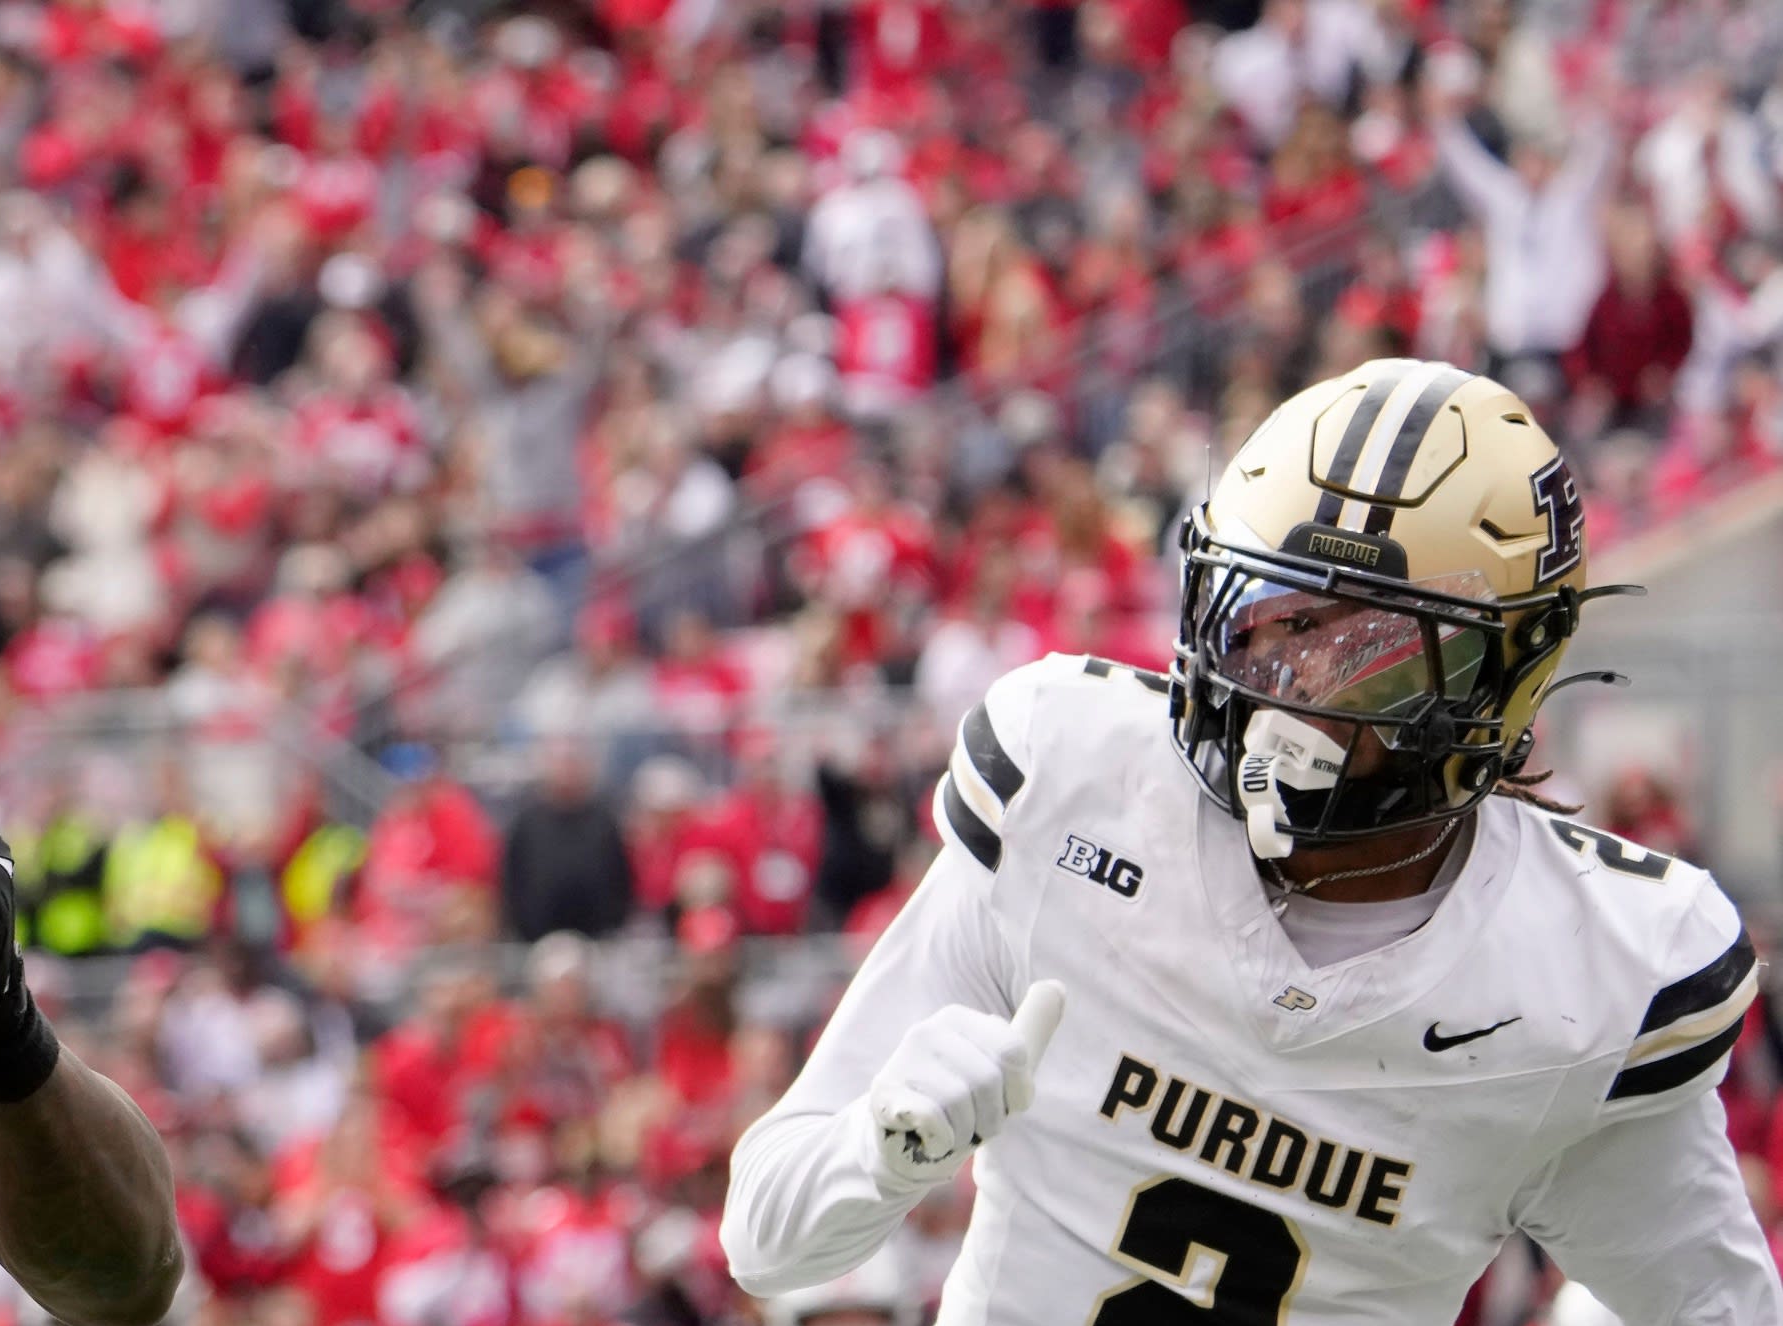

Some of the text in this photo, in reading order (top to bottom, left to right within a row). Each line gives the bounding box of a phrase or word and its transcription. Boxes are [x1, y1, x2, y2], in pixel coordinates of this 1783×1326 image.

[1308, 533, 1381, 567] PURDUE
[1243, 753, 1275, 793] RND
[1099, 1050, 1416, 1229] PURDUE
